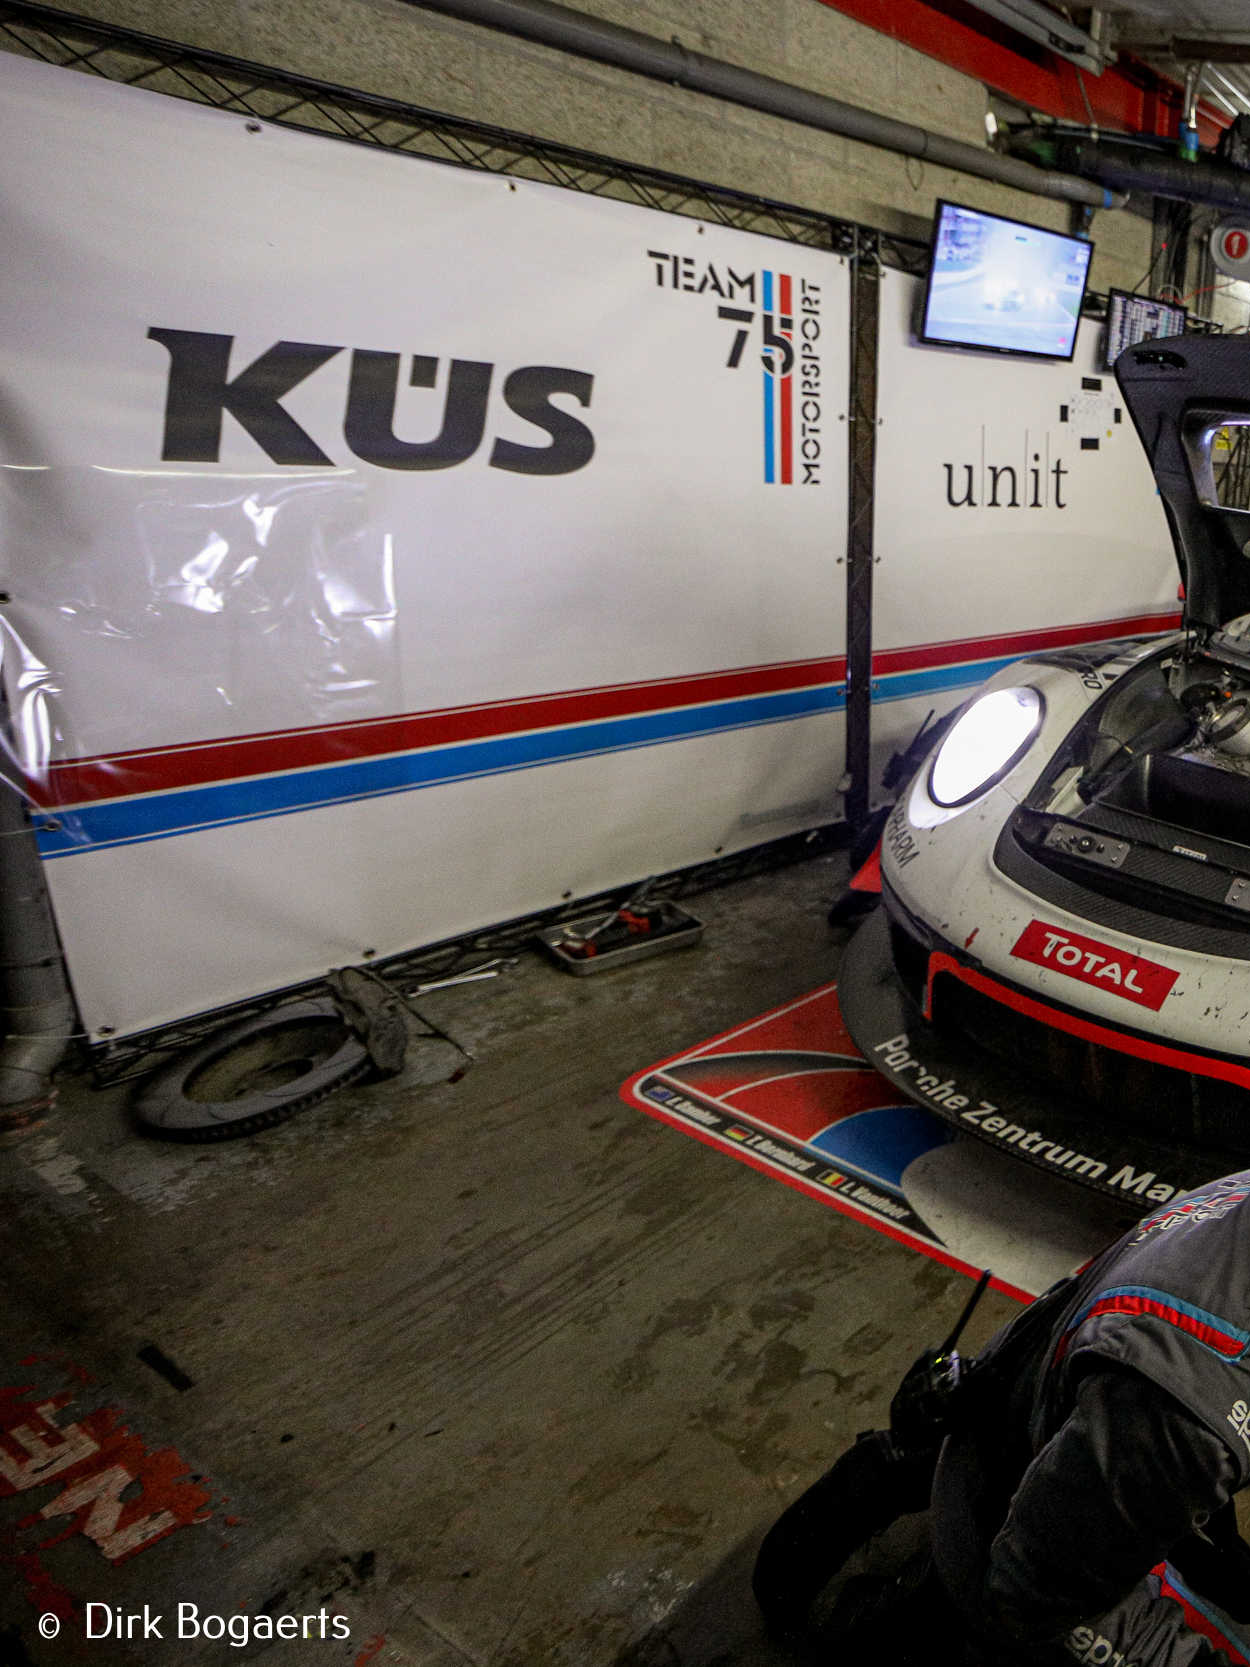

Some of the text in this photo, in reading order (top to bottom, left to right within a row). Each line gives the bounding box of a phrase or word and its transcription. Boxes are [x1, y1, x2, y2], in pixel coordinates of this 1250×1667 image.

[647, 249, 756, 304] TEAM
[717, 304, 794, 376] 75
[147, 327, 597, 477] KÜS
[801, 277, 821, 485] MOTORSPORT
[944, 453, 1069, 508] unit
[1040, 930, 1145, 995] TOTAL
[874, 1033, 970, 1111] Porche
[960, 1101, 1109, 1179] Zentrum
